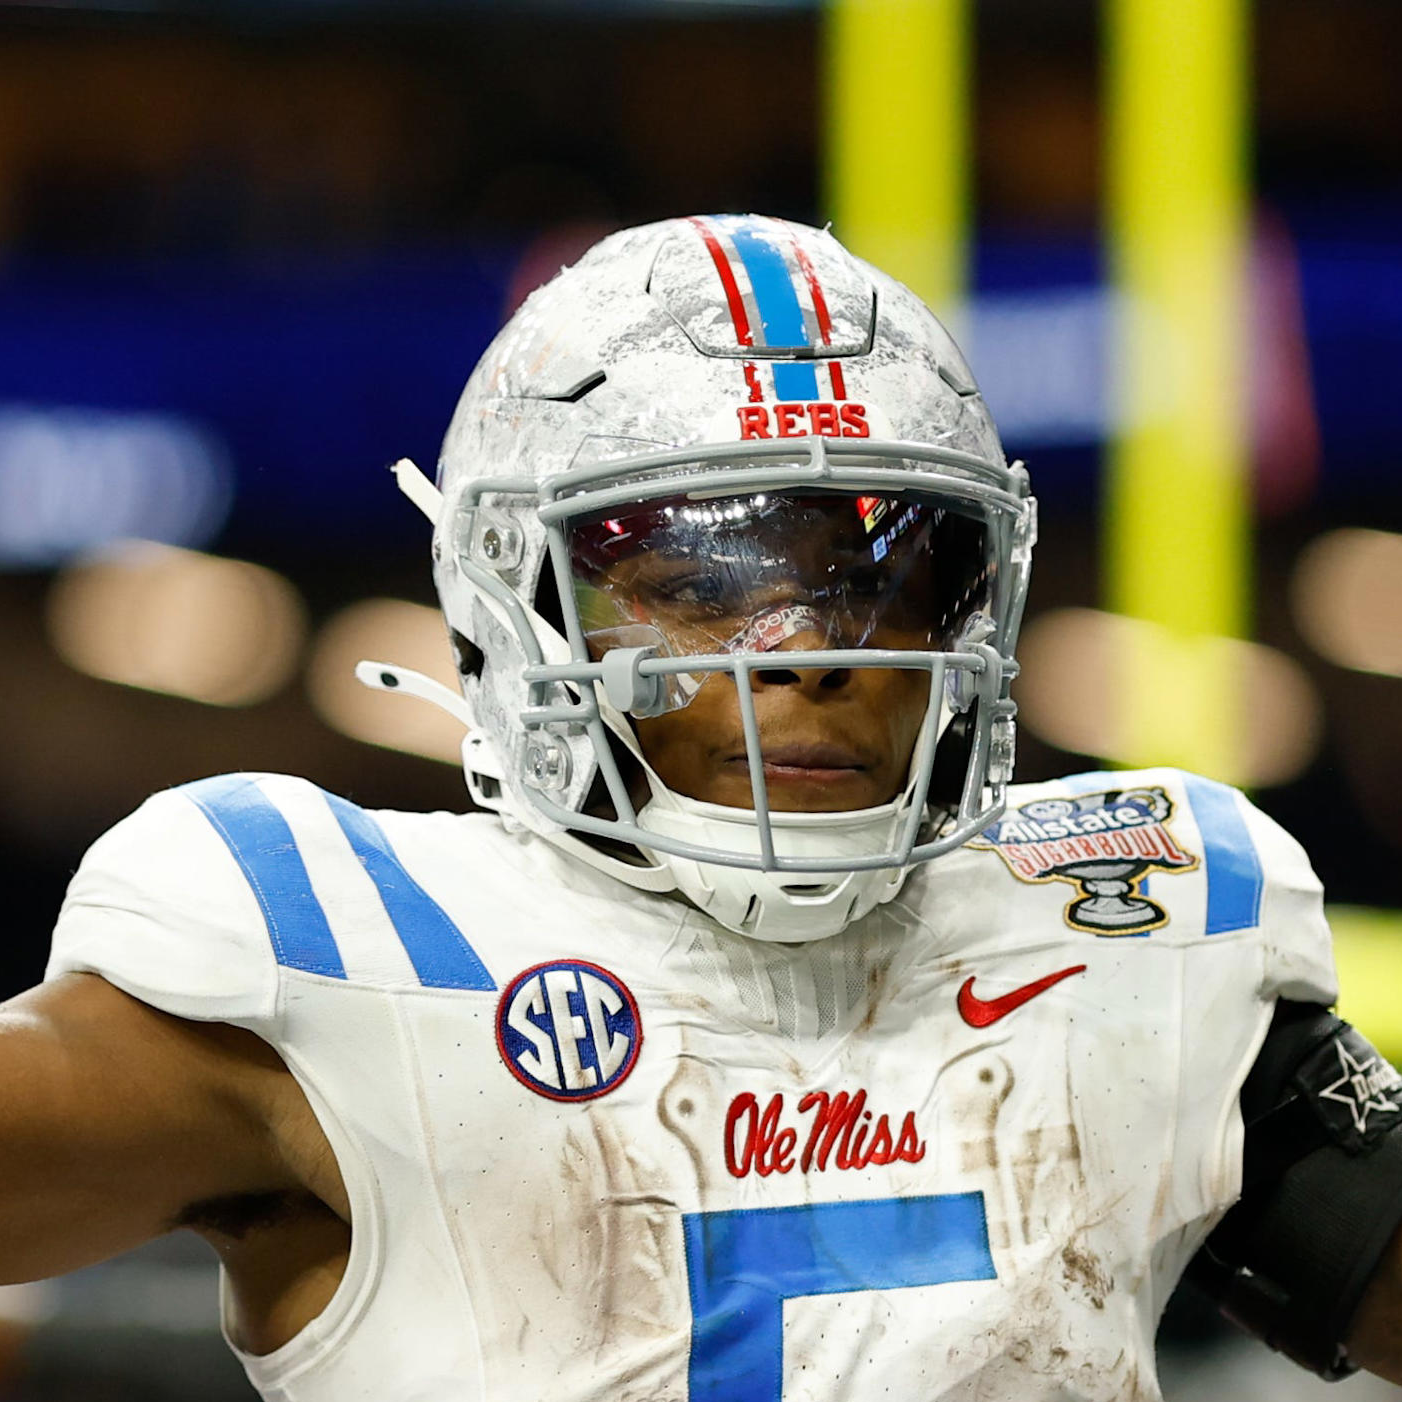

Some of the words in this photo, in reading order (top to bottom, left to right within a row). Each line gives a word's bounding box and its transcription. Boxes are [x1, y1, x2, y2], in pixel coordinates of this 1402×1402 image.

[737, 403, 870, 441] REBS
[999, 806, 1141, 844] Allstate
[507, 969, 631, 1091] SEC
[724, 1091, 798, 1179] Ole
[796, 1088, 927, 1175] Miss
